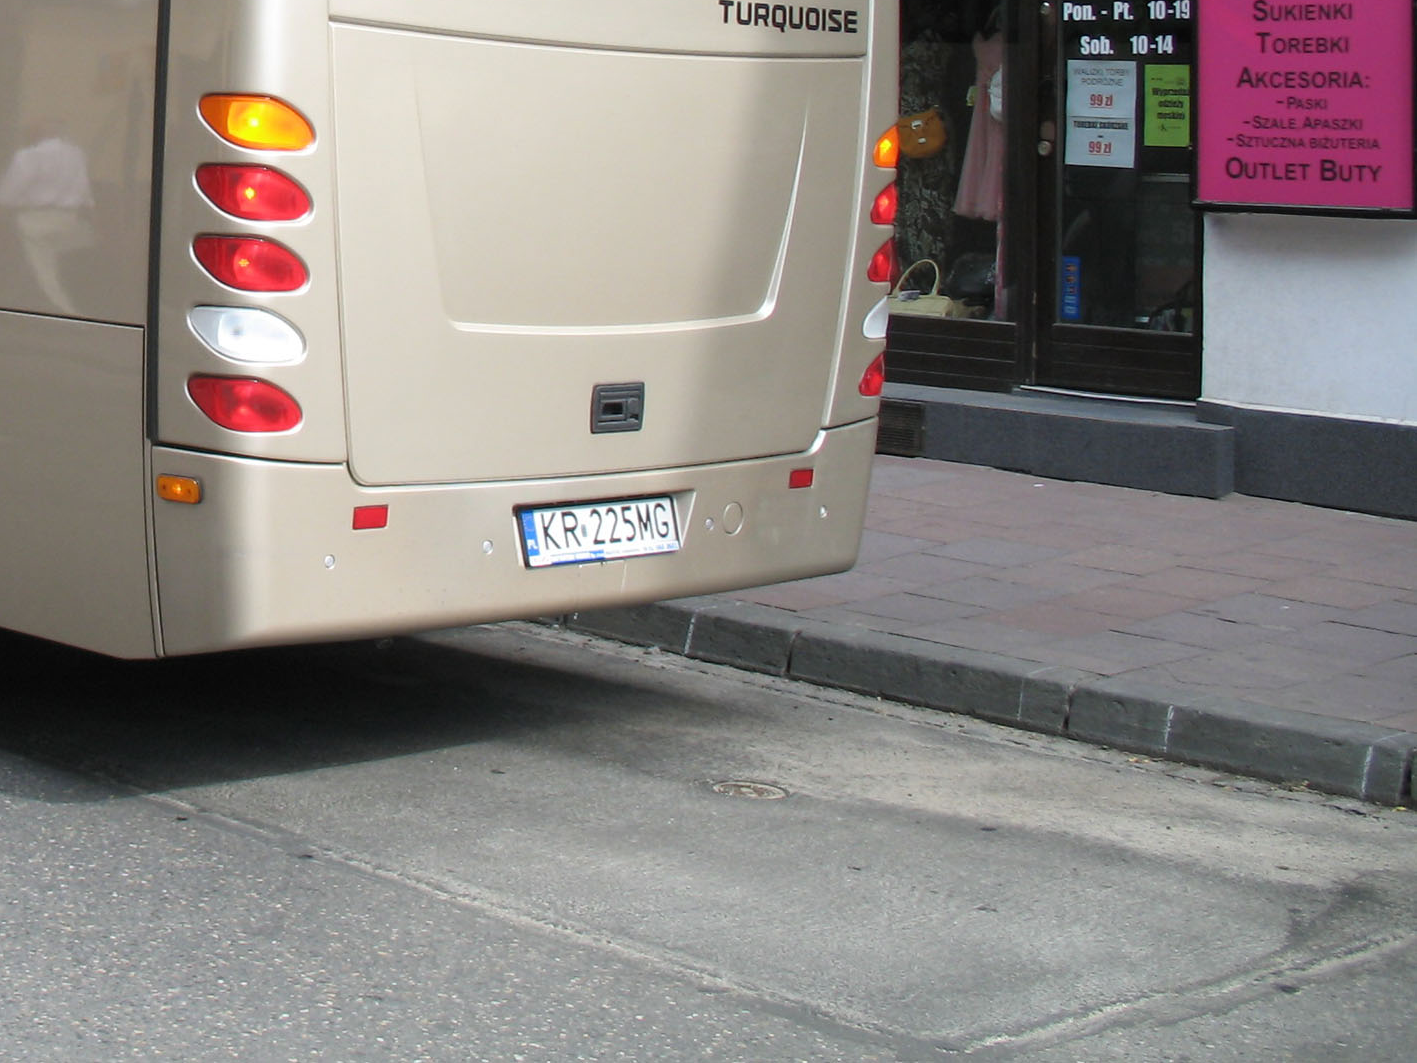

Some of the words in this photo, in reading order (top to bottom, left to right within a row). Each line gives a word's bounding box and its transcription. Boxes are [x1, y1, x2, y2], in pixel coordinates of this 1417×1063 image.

[718, 0, 858, 34] TURQUOISE
[1062, 1, 1097, 21] Pon.
[1113, 1, 1135, 20] Pt.
[1147, 0, 1191, 20] 10-19
[1252, 0, 1353, 22] SUKIENKI
[1079, 35, 1115, 55] Sob.
[1129, 34, 1174, 55] 10-14
[1255, 32, 1350, 54] TOREBKI
[1236, 67, 1372, 89] AKCESORIA:
[1089, 93, 1103, 107] 99
[1302, 116, 1364, 131] APASZKI
[1088, 140, 1102, 154] 99
[1225, 156, 1311, 181] OUTLET
[1319, 158, 1383, 183] BUTY
[540, 510, 582, 550] KR
[589, 502, 670, 546] 225MG
